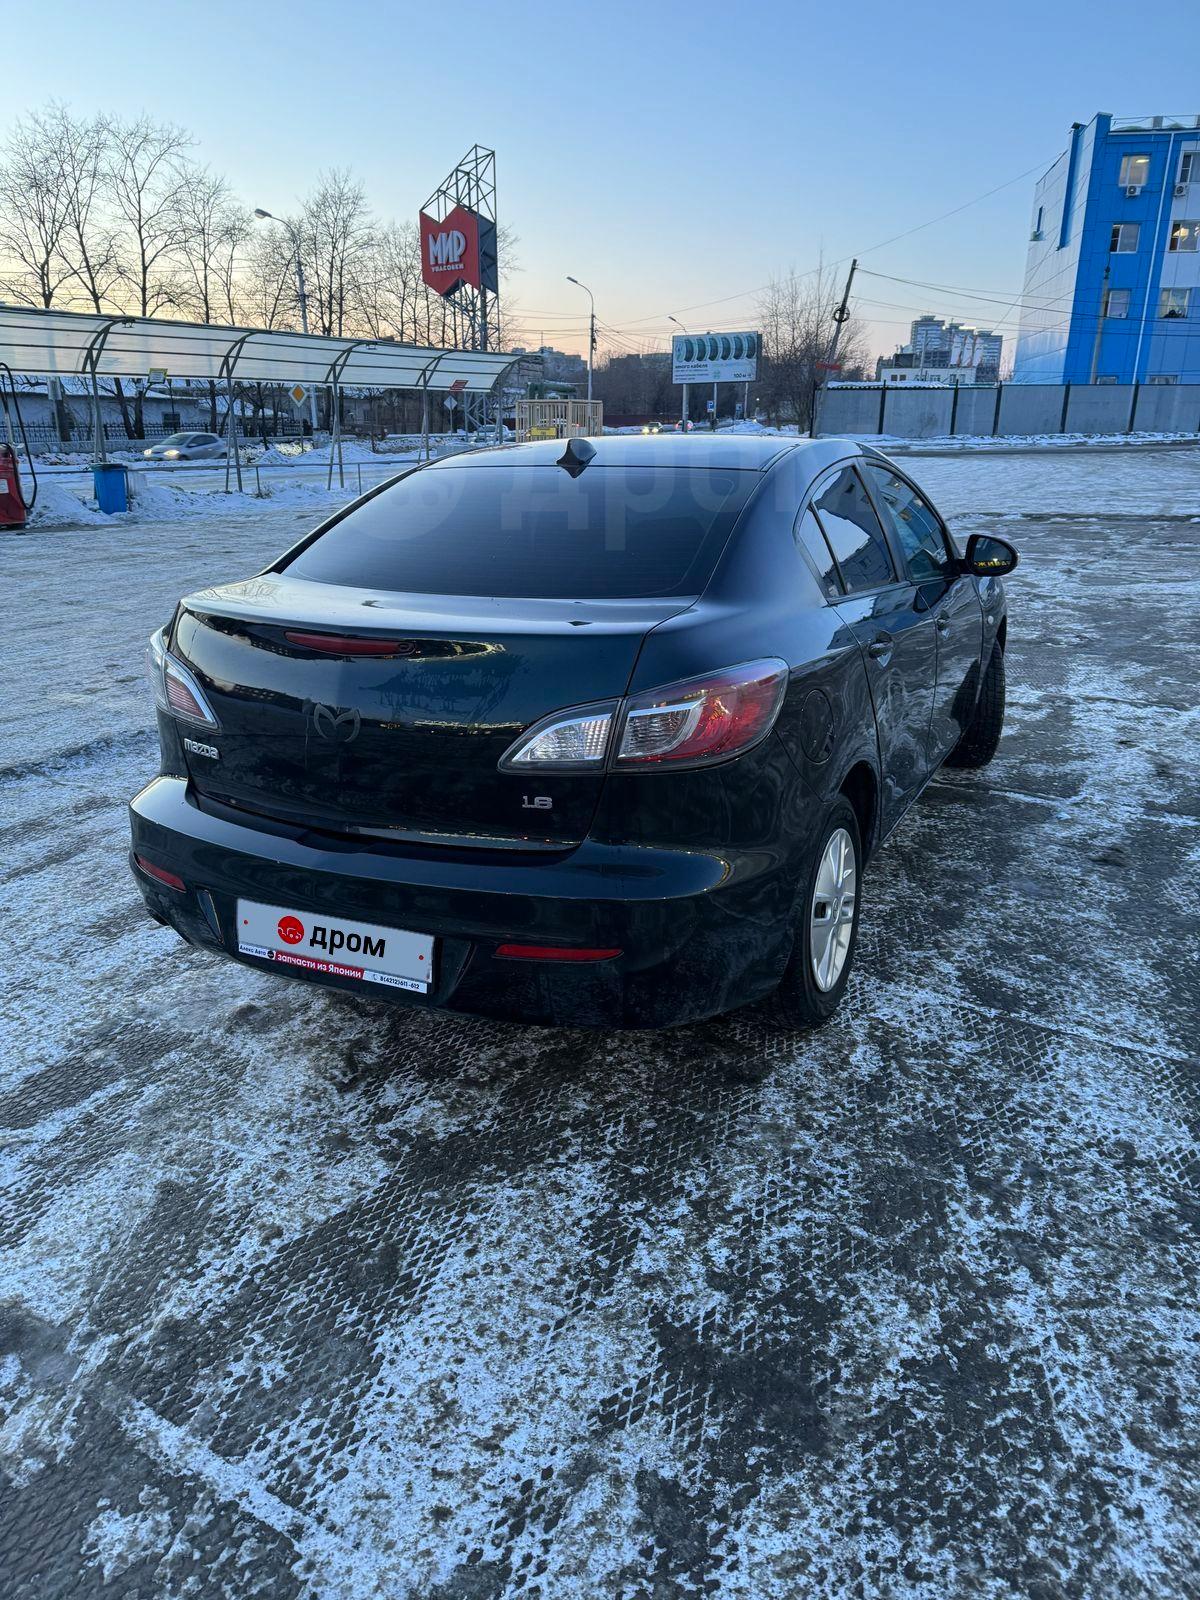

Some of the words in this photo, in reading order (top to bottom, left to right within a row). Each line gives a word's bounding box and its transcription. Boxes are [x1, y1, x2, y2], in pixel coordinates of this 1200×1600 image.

[429, 230, 466, 265] МИР
[184, 737, 219, 760] mazda
[255, 948, 267, 956] Авто
[310, 926, 386, 957] дром
[277, 954, 316, 969] запчасти
[317, 963, 327, 971] из
[328, 964, 361, 978] Японии
